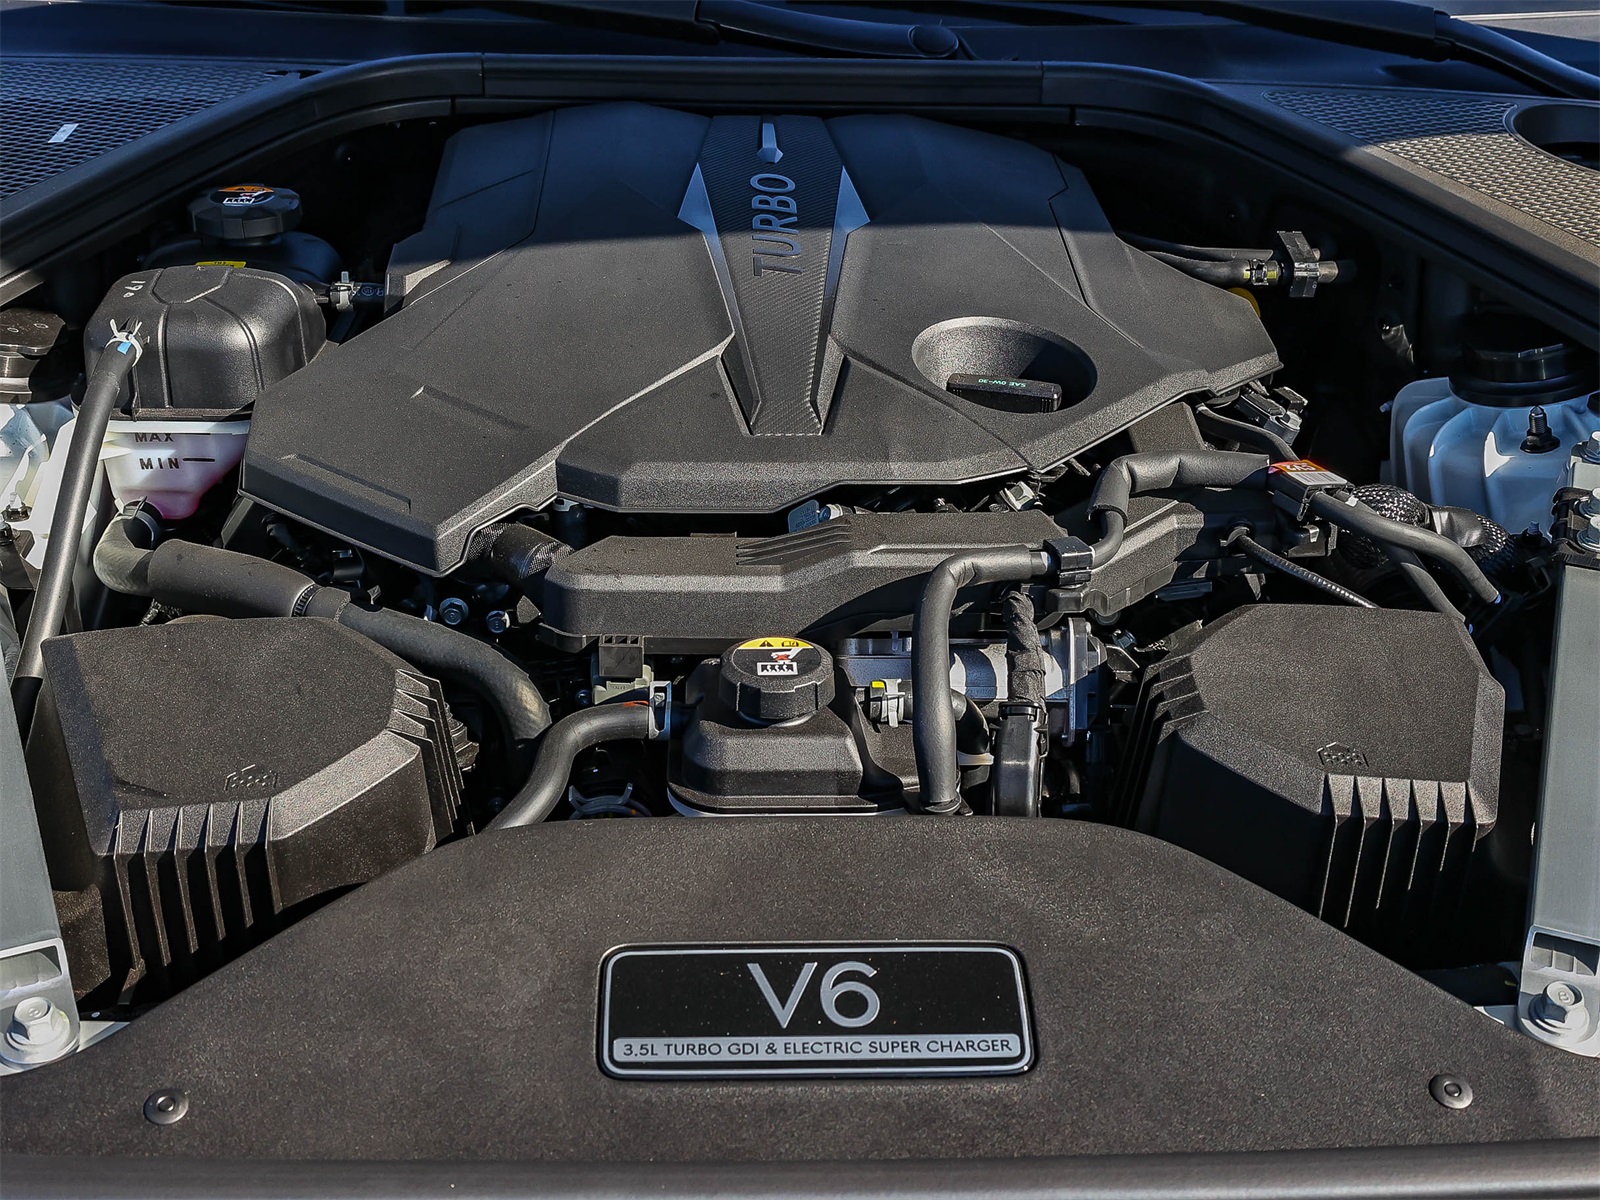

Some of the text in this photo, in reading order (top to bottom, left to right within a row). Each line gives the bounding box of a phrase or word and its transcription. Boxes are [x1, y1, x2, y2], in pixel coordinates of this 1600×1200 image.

[750, 173, 805, 276] TURBO
[1008, 380, 1027, 388] SAE
[133, 432, 174, 442] MAX
[139, 457, 180, 470] MIN
[747, 961, 881, 1028] V6
[623, 1040, 1012, 1057] 3.5L TURBO GDI & ELECTRIC SUPER CHARGER
